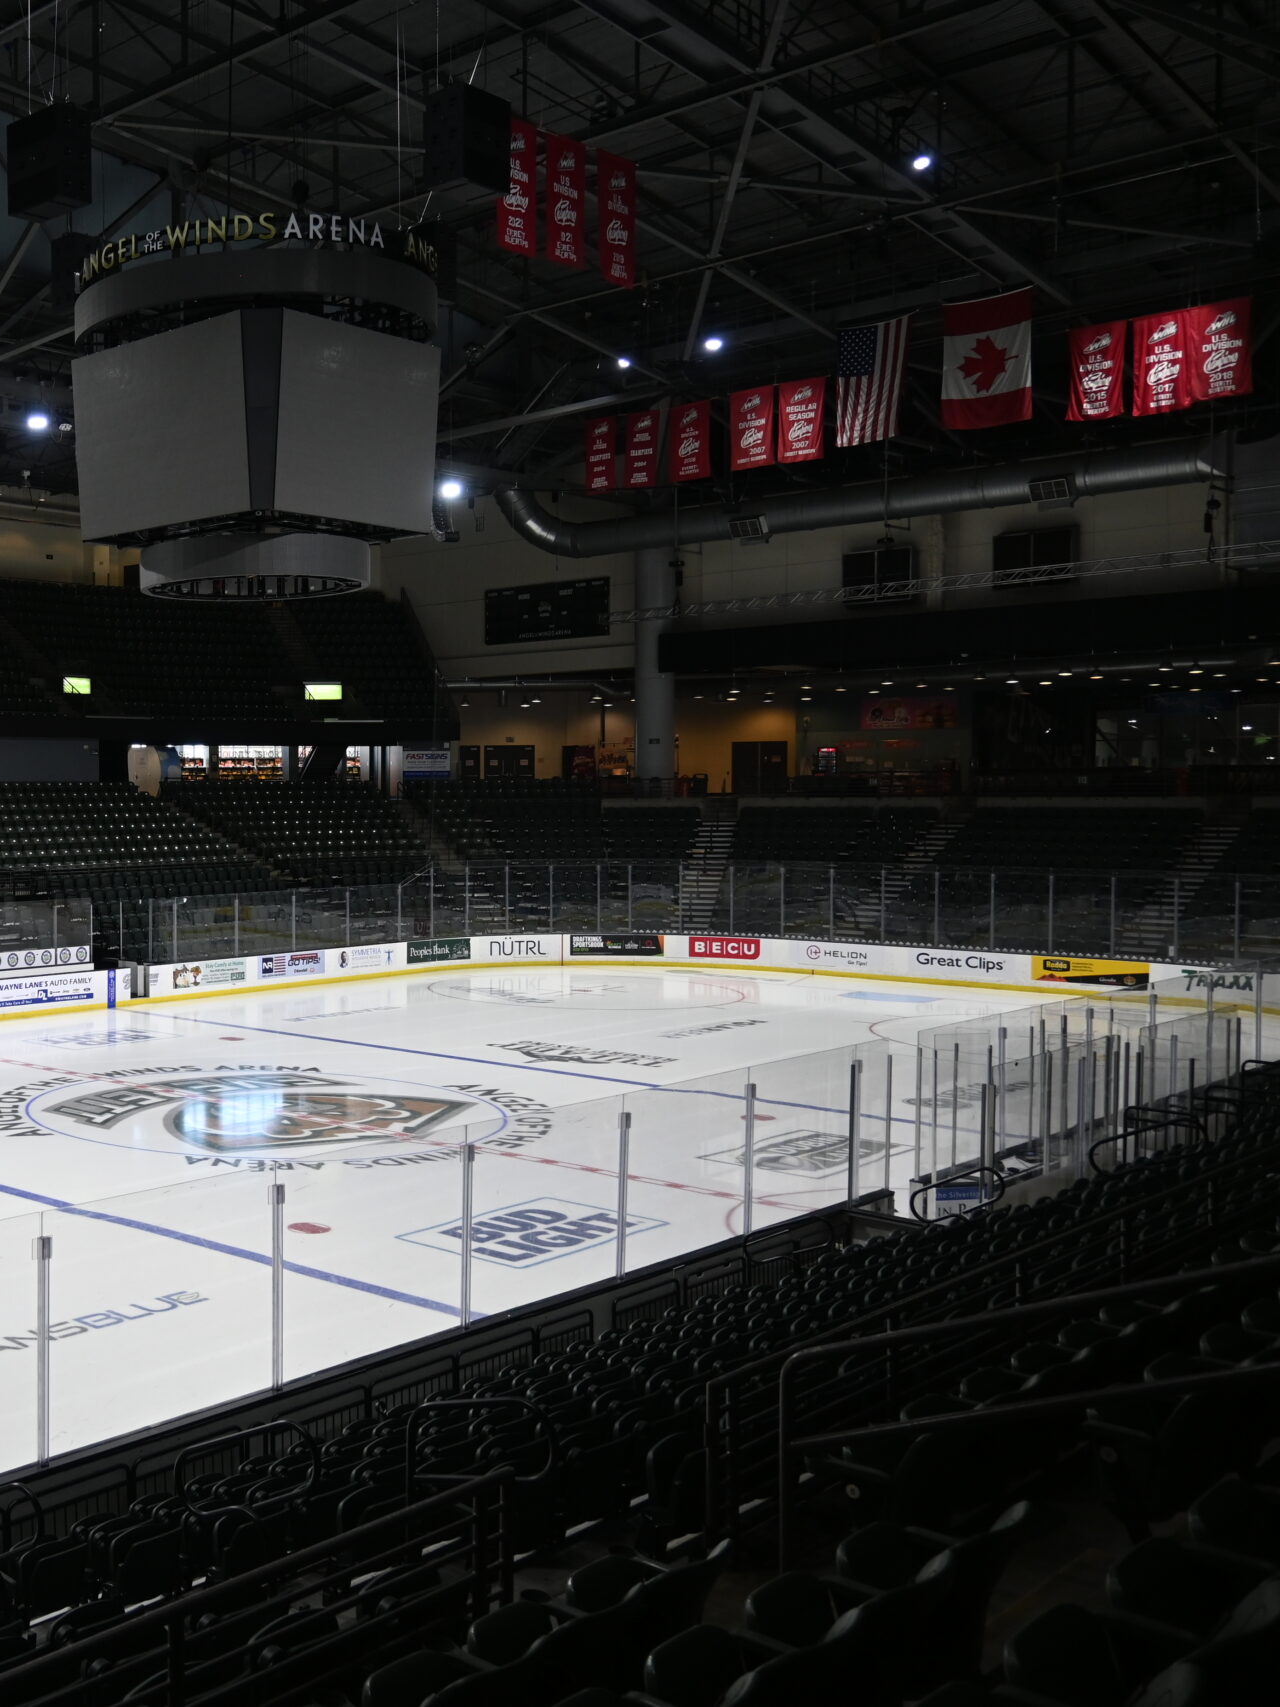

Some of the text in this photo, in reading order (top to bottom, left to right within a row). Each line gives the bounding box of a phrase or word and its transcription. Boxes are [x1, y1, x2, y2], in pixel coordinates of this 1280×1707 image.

[553, 182, 578, 200] DIVISION
[81, 211, 385, 283] ANGEL OF THE WINDS ARENA
[1211, 333, 1231, 343] U.S.
[1154, 344, 1173, 353] U.S.
[1202, 339, 1243, 353] DIVISION
[1088, 355, 1105, 364] U.S.
[1145, 350, 1183, 364] DIVISION
[1079, 360, 1114, 373] DIVISION
[1208, 371, 1234, 382] 2018
[1152, 383, 1174, 394] 2017
[1085, 391, 1107, 401] 2015
[785, 402, 817, 413] REGULAR
[788, 411, 815, 420] SEASON
[738, 418, 766, 429] DIVISION
[791, 440, 809, 449] 2007
[749, 446, 766, 455] 2007
[409, 943, 451, 959] Peoples Bank
[489, 937, 548, 957] NÜTRL
[824, 950, 867, 960] HELION
[287, 959, 301, 967] GO
[301, 956, 321, 965] TIPS!
[916, 952, 1005, 973] Great Clips
[49, 978, 69, 987] AUTO
[69, 976, 93, 986] FAMILY
[92, 1065, 203, 1079] WINDS
[214, 1064, 322, 1073] ARENA
[441, 1084, 556, 1113] ANGEL
[183, 1154, 325, 1172] ARENA
[437, 1208, 568, 1243] BUD
[470, 1212, 640, 1262] LIGHT
